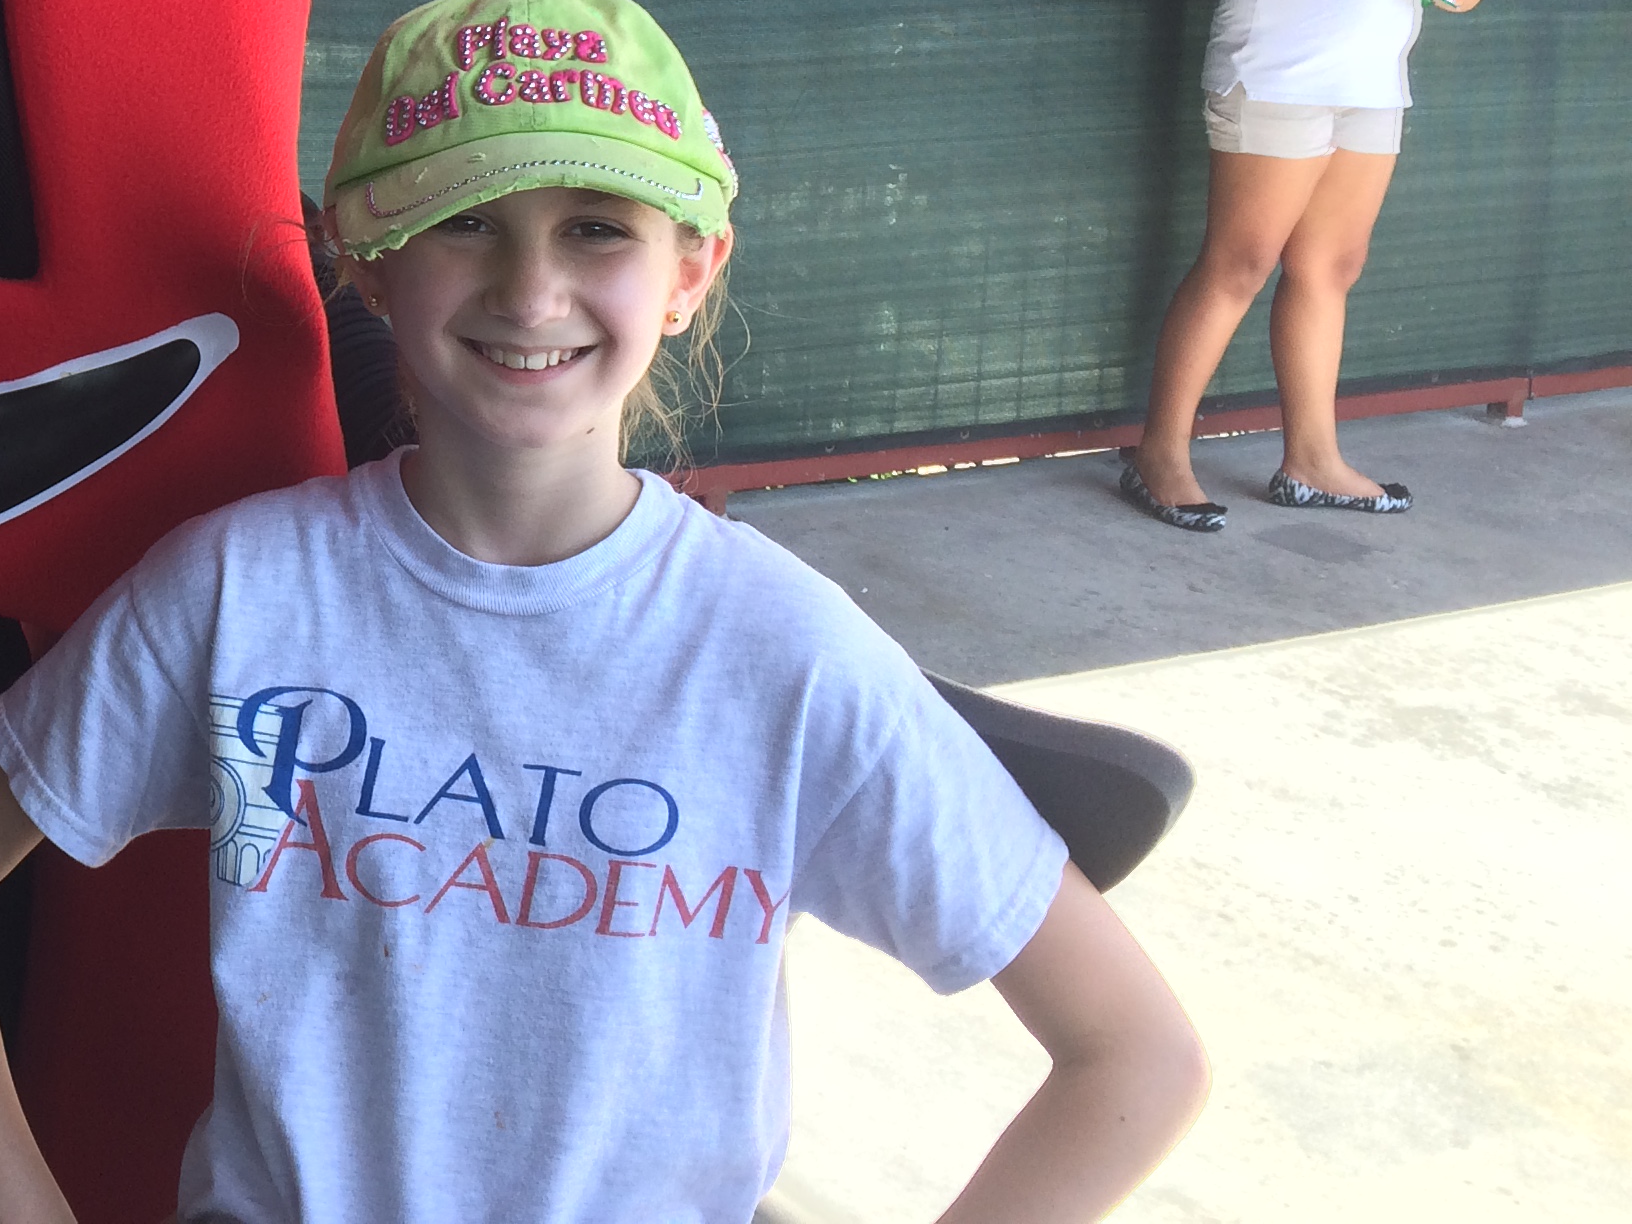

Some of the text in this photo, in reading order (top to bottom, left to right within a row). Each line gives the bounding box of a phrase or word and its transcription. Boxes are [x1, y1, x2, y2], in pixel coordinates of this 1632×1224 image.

[384, 62, 683, 147] Del Carmen
[456, 16, 609, 72] Playa
[236, 685, 680, 857] PLATO
[247, 778, 791, 945] ACADEMY
